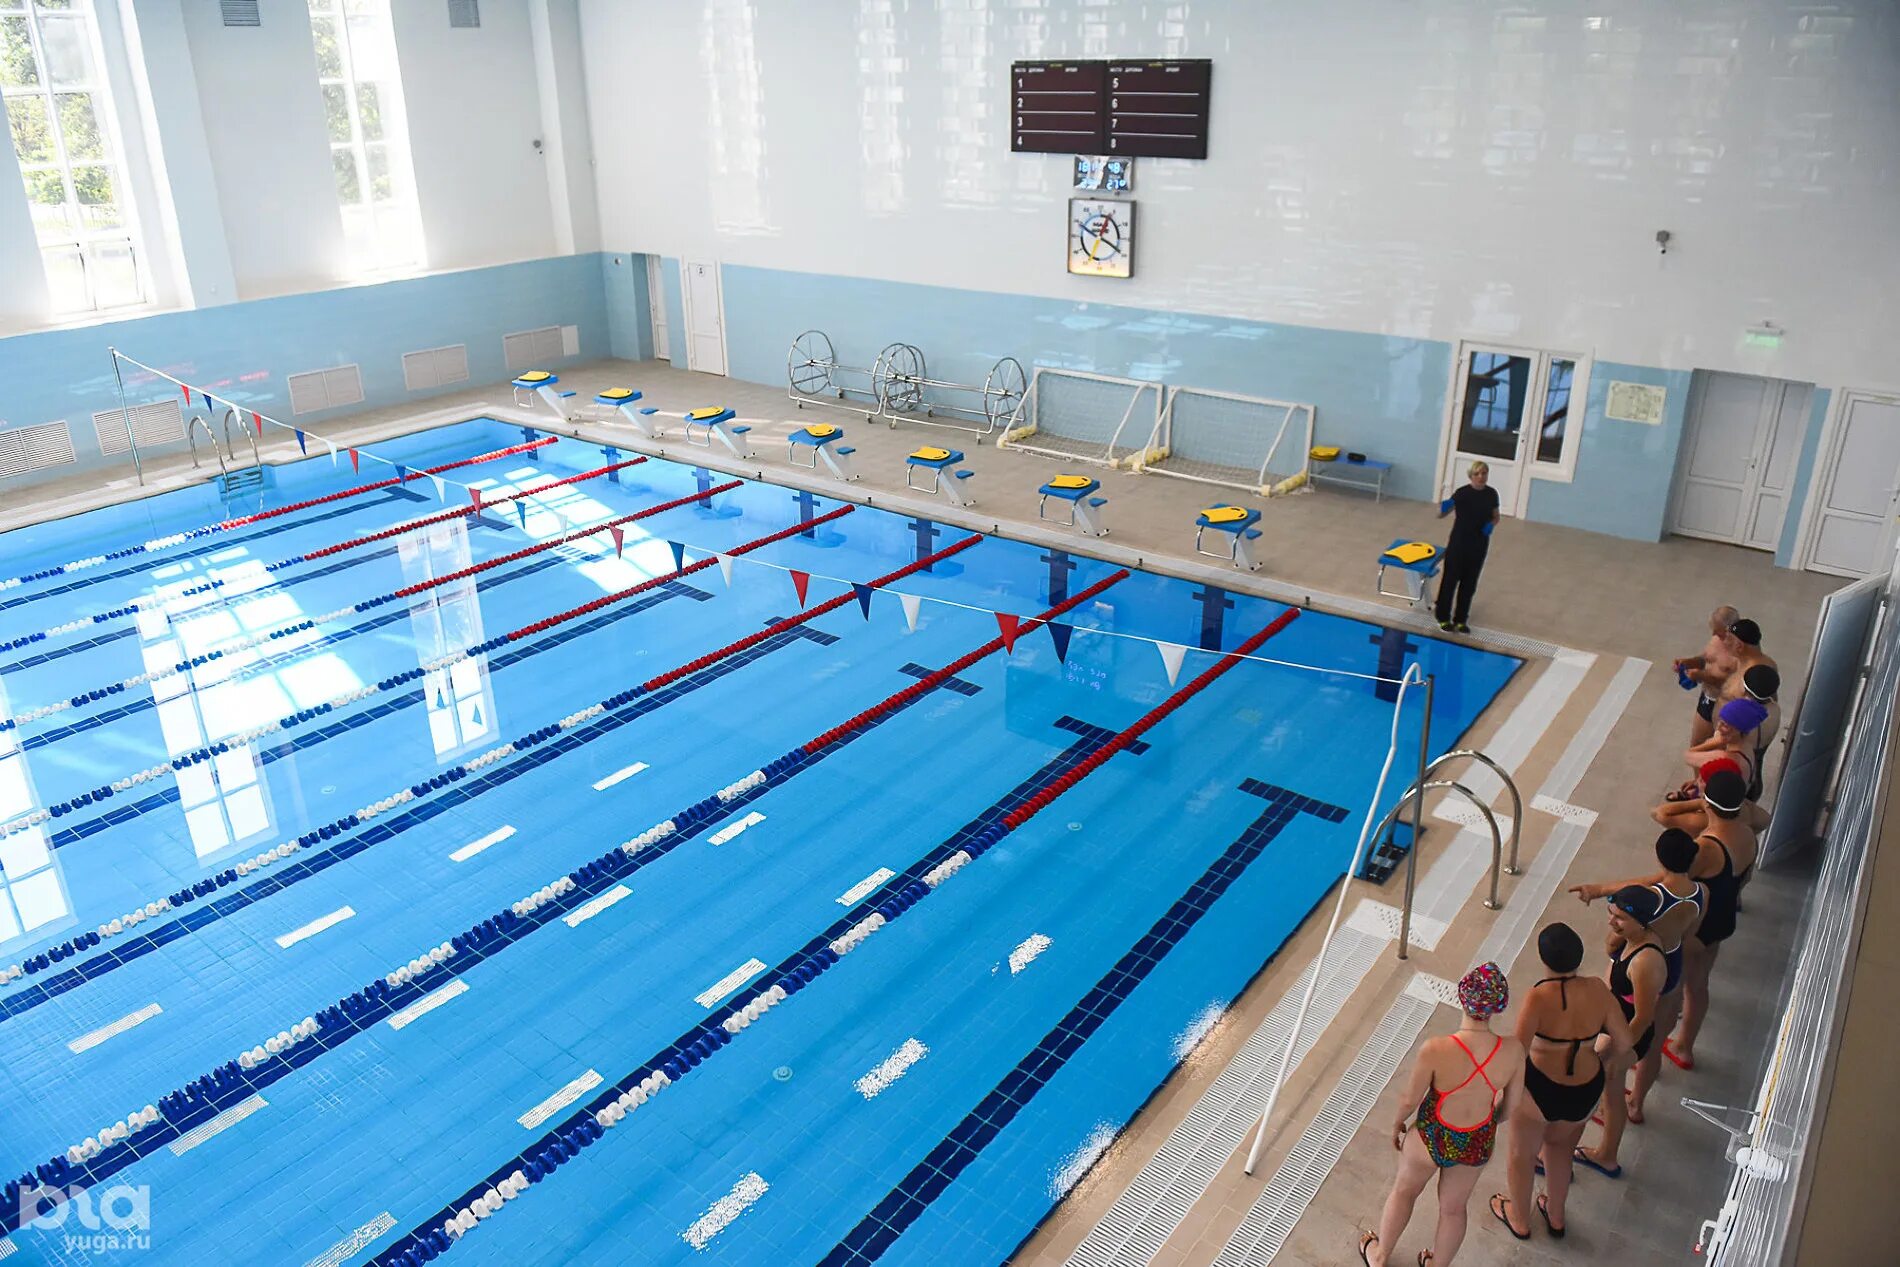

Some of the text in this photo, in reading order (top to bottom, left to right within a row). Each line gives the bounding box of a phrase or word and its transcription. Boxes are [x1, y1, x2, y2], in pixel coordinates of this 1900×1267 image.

[1018, 78, 1023, 88] 1
[1112, 77, 1119, 89] 5
[1017, 97, 1023, 108] 2
[1111, 98, 1118, 109] 6
[1017, 117, 1023, 127] 3
[1111, 118, 1118, 129] 7
[1017, 136, 1023, 146] 4
[1110, 138, 1117, 149] 8
